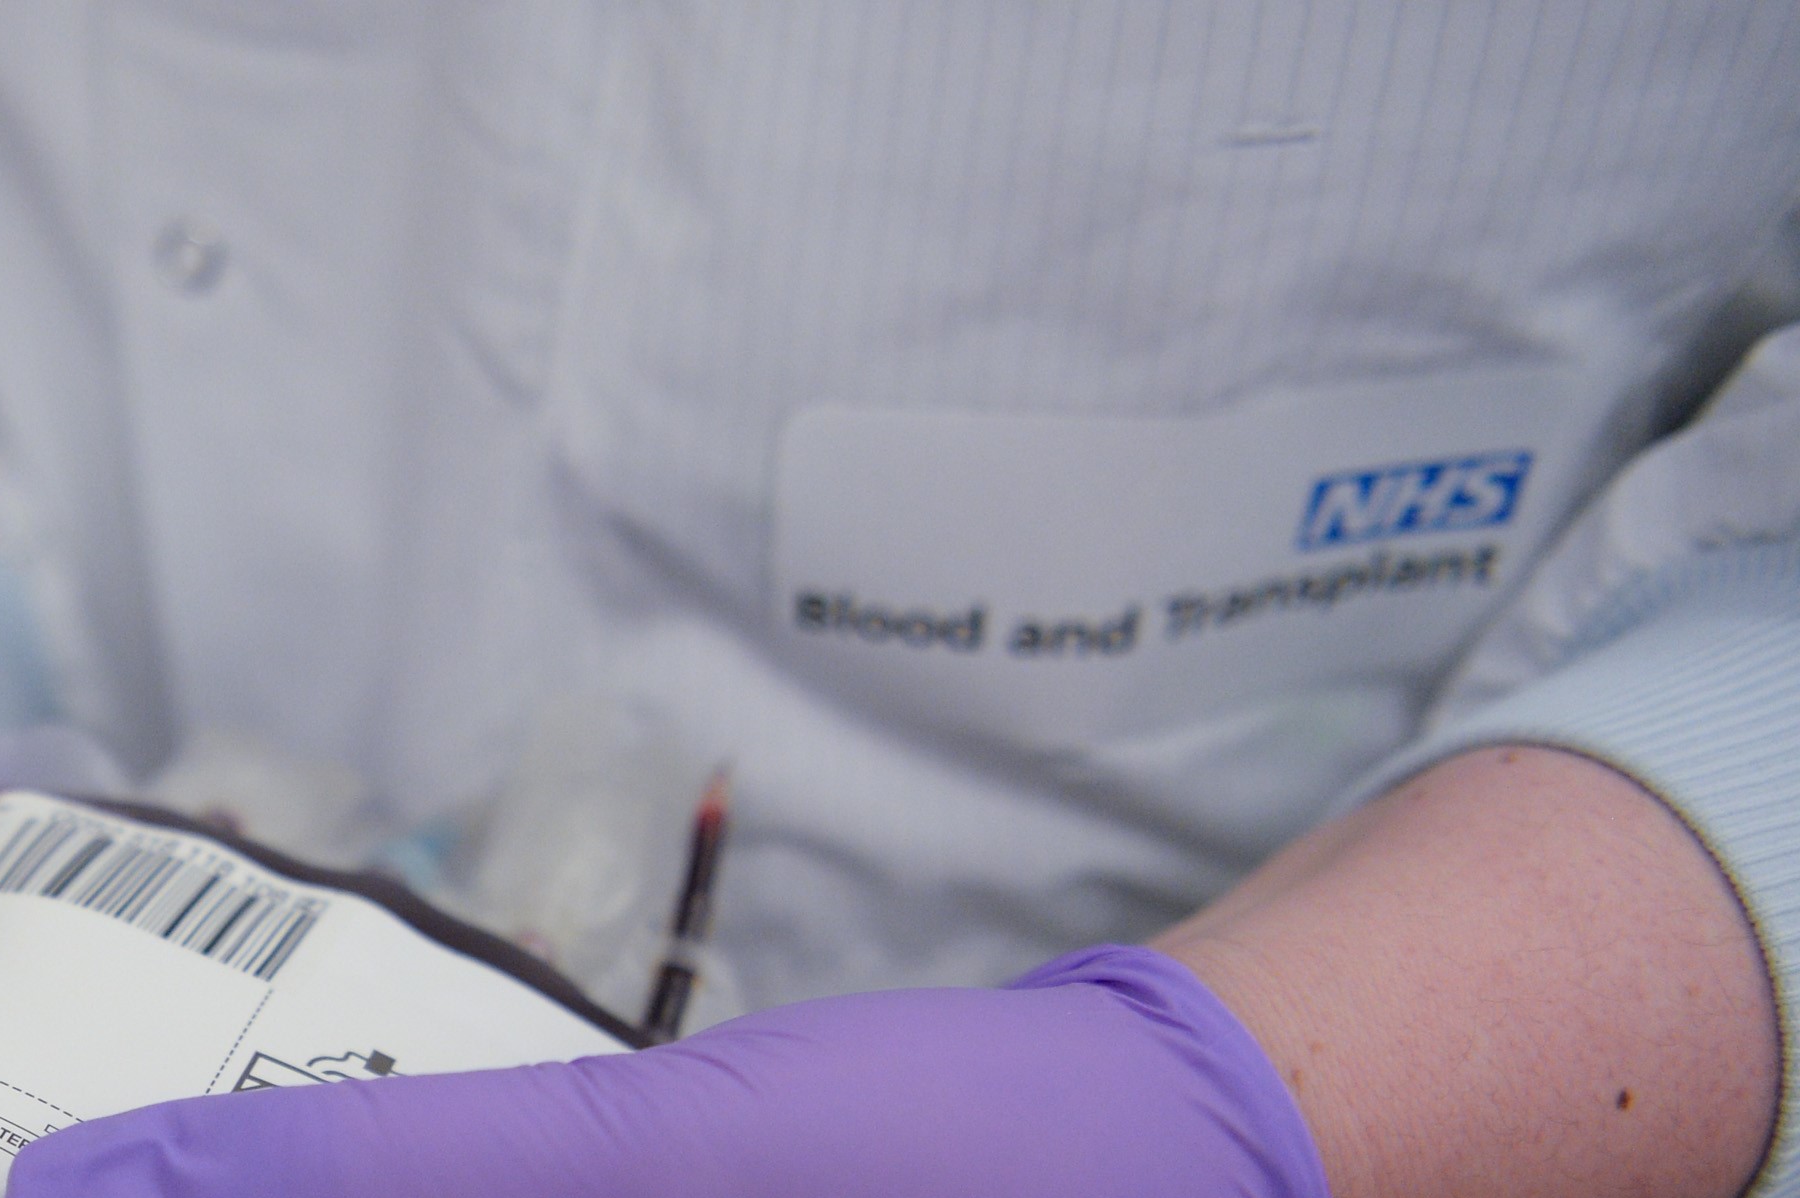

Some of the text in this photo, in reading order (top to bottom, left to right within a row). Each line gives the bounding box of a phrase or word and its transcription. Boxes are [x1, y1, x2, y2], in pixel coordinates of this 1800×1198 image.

[1306, 460, 1522, 543] NHS
[795, 544, 1501, 658] Blood and Transplant
